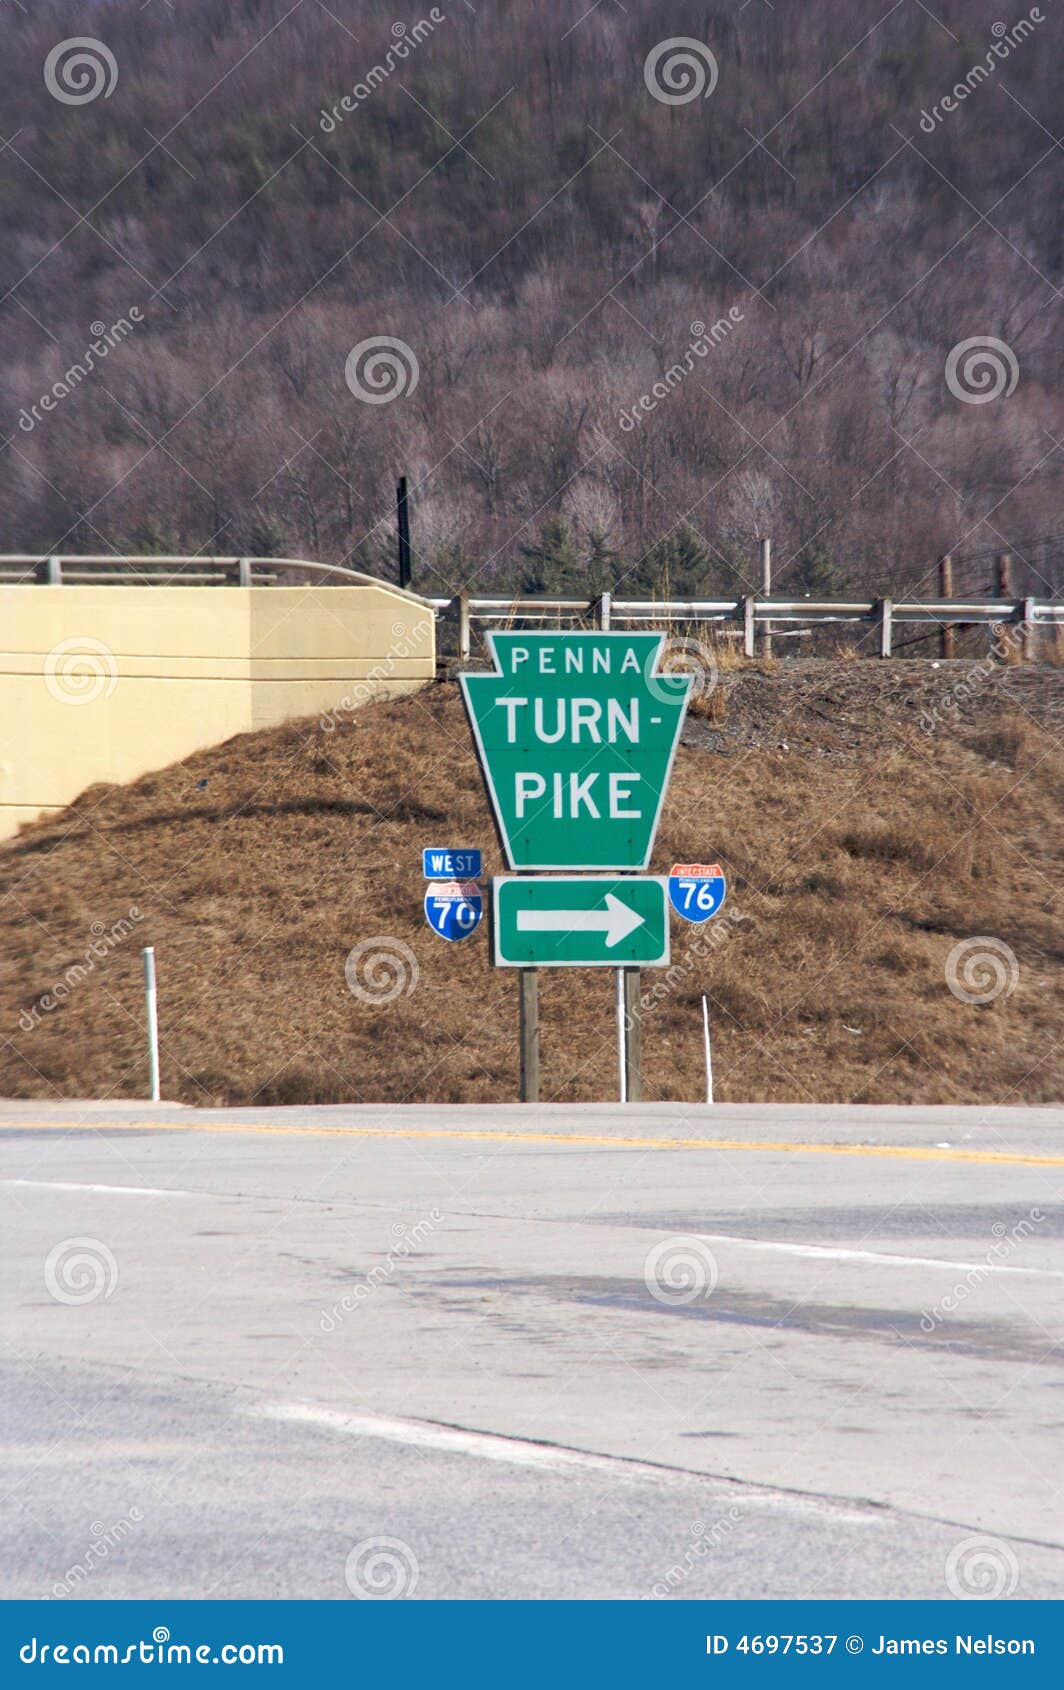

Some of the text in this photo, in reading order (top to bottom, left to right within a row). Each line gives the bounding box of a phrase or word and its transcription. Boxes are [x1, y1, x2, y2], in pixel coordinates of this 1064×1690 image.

[511, 647, 641, 674] PENNA
[495, 697, 662, 744] TURN-
[514, 772, 642, 819] PIKE
[431, 854, 474, 873] WEST
[678, 882, 715, 911] 76
[432, 902, 476, 930] 70
